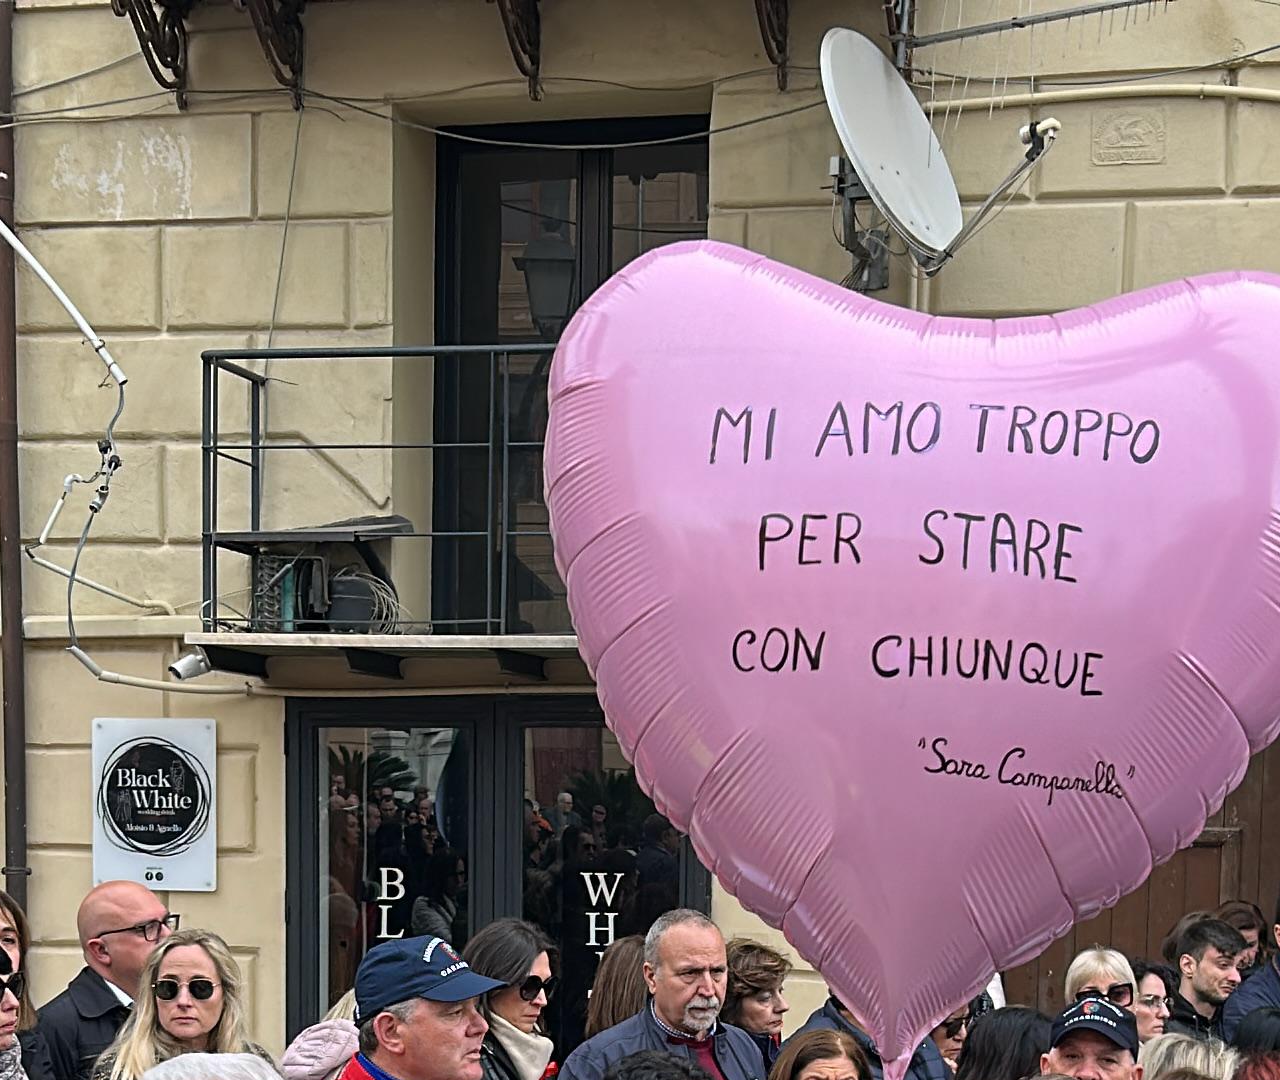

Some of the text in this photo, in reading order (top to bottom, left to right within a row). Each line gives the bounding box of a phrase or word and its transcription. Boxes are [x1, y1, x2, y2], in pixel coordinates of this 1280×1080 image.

[710, 401, 1161, 464] MI AMO TROPPO
[758, 510, 1083, 583] PER STARE
[732, 628, 1104, 697] CON CHIUNQUE
[117, 768, 171, 788] Black
[133, 790, 192, 809] White
